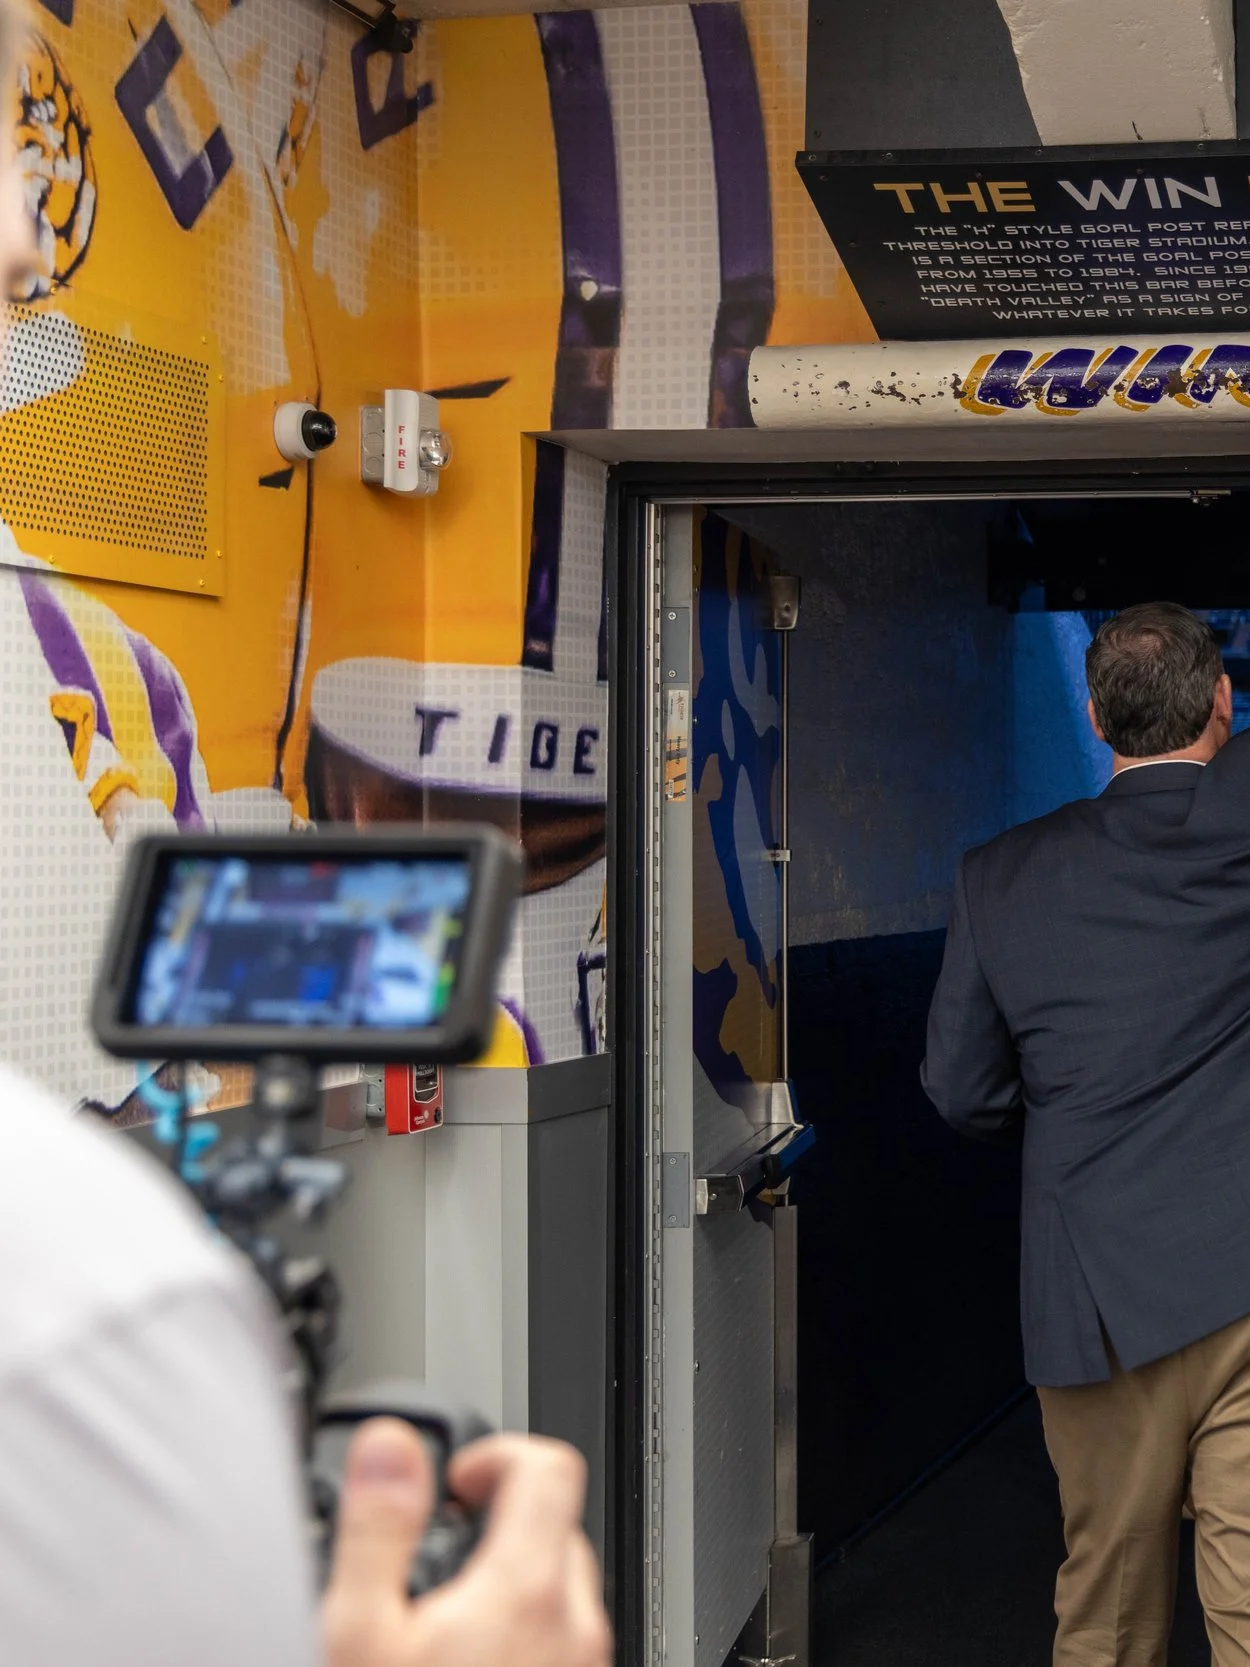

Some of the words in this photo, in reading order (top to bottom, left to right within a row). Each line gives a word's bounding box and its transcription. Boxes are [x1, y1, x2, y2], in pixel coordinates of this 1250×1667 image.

[873, 181, 1036, 214] THE
[1057, 176, 1223, 211] WIN
[914, 226, 957, 236] THE
[1004, 225, 1073, 235] STYLE
[1080, 223, 1141, 234] GOAL
[1147, 221, 1206, 232] POST
[883, 240, 1013, 251] THRESHOLD
[1020, 239, 1069, 250] INTO
[1076, 238, 1141, 248] TIGER
[912, 256, 932, 265] IS
[939, 255, 954, 265] A
[962, 254, 1052, 265] SECTION
[1058, 253, 1086, 263] OF
[1092, 252, 1136, 262] THE
[1143, 251, 1203, 262] GOAL
[916, 270, 977, 279] FROM
[983, 269, 1038, 279] 1955
[1044, 268, 1073, 278] TO
[1080, 267, 1141, 277] 1984.
[1154, 265, 1216, 276] SINCE
[920, 283, 977, 293] HAVE
[983, 282, 1083, 292] TOUCHED
[1089, 281, 1139, 291] THIS
[1145, 279, 1190, 290] BAR
[920, 296, 1001, 307] "DEATH
[1008, 294, 1095, 306] VALLEY"
[1103, 295, 1132, 305] AS
[1138, 294, 1153, 304] A
[1160, 292, 1210, 303] SIGN
[1217, 291, 1245, 302] OF
[992, 308, 1110, 320] WHATEVER
[1117, 308, 1136, 318] IT
[1143, 306, 1214, 317] TAKES
[397, 425, 406, 470] FIRE
